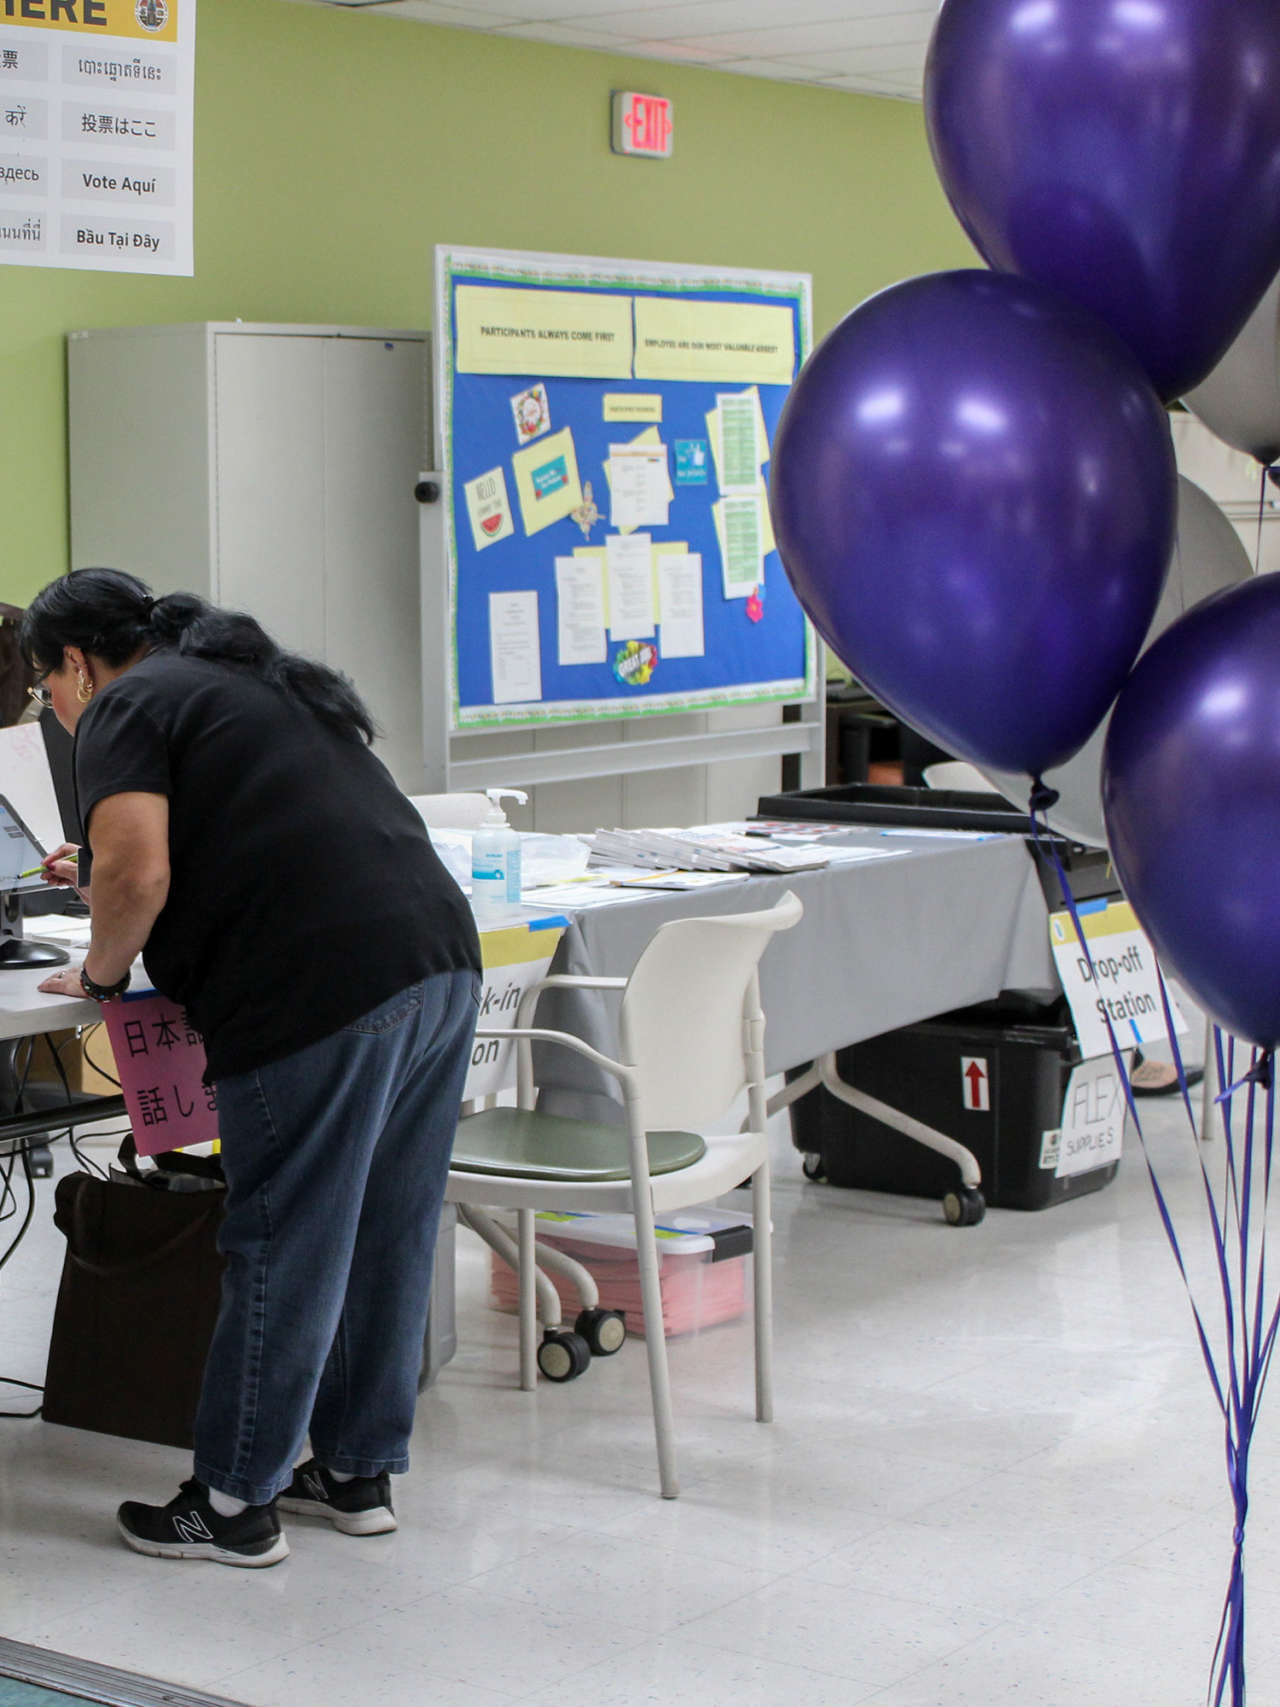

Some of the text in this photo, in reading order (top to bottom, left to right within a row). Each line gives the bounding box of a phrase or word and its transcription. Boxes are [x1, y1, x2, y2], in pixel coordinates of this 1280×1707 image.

[81, 113, 156, 137] 投票はここ
[631, 95, 669, 152] EXIT
[82, 173, 157, 196] Vote Aquí
[480, 325, 615, 342] PARTICIPANTS ALWAYS COME FIRST
[1076, 945, 1144, 985] Drop-off
[1096, 991, 1157, 1024] Station
